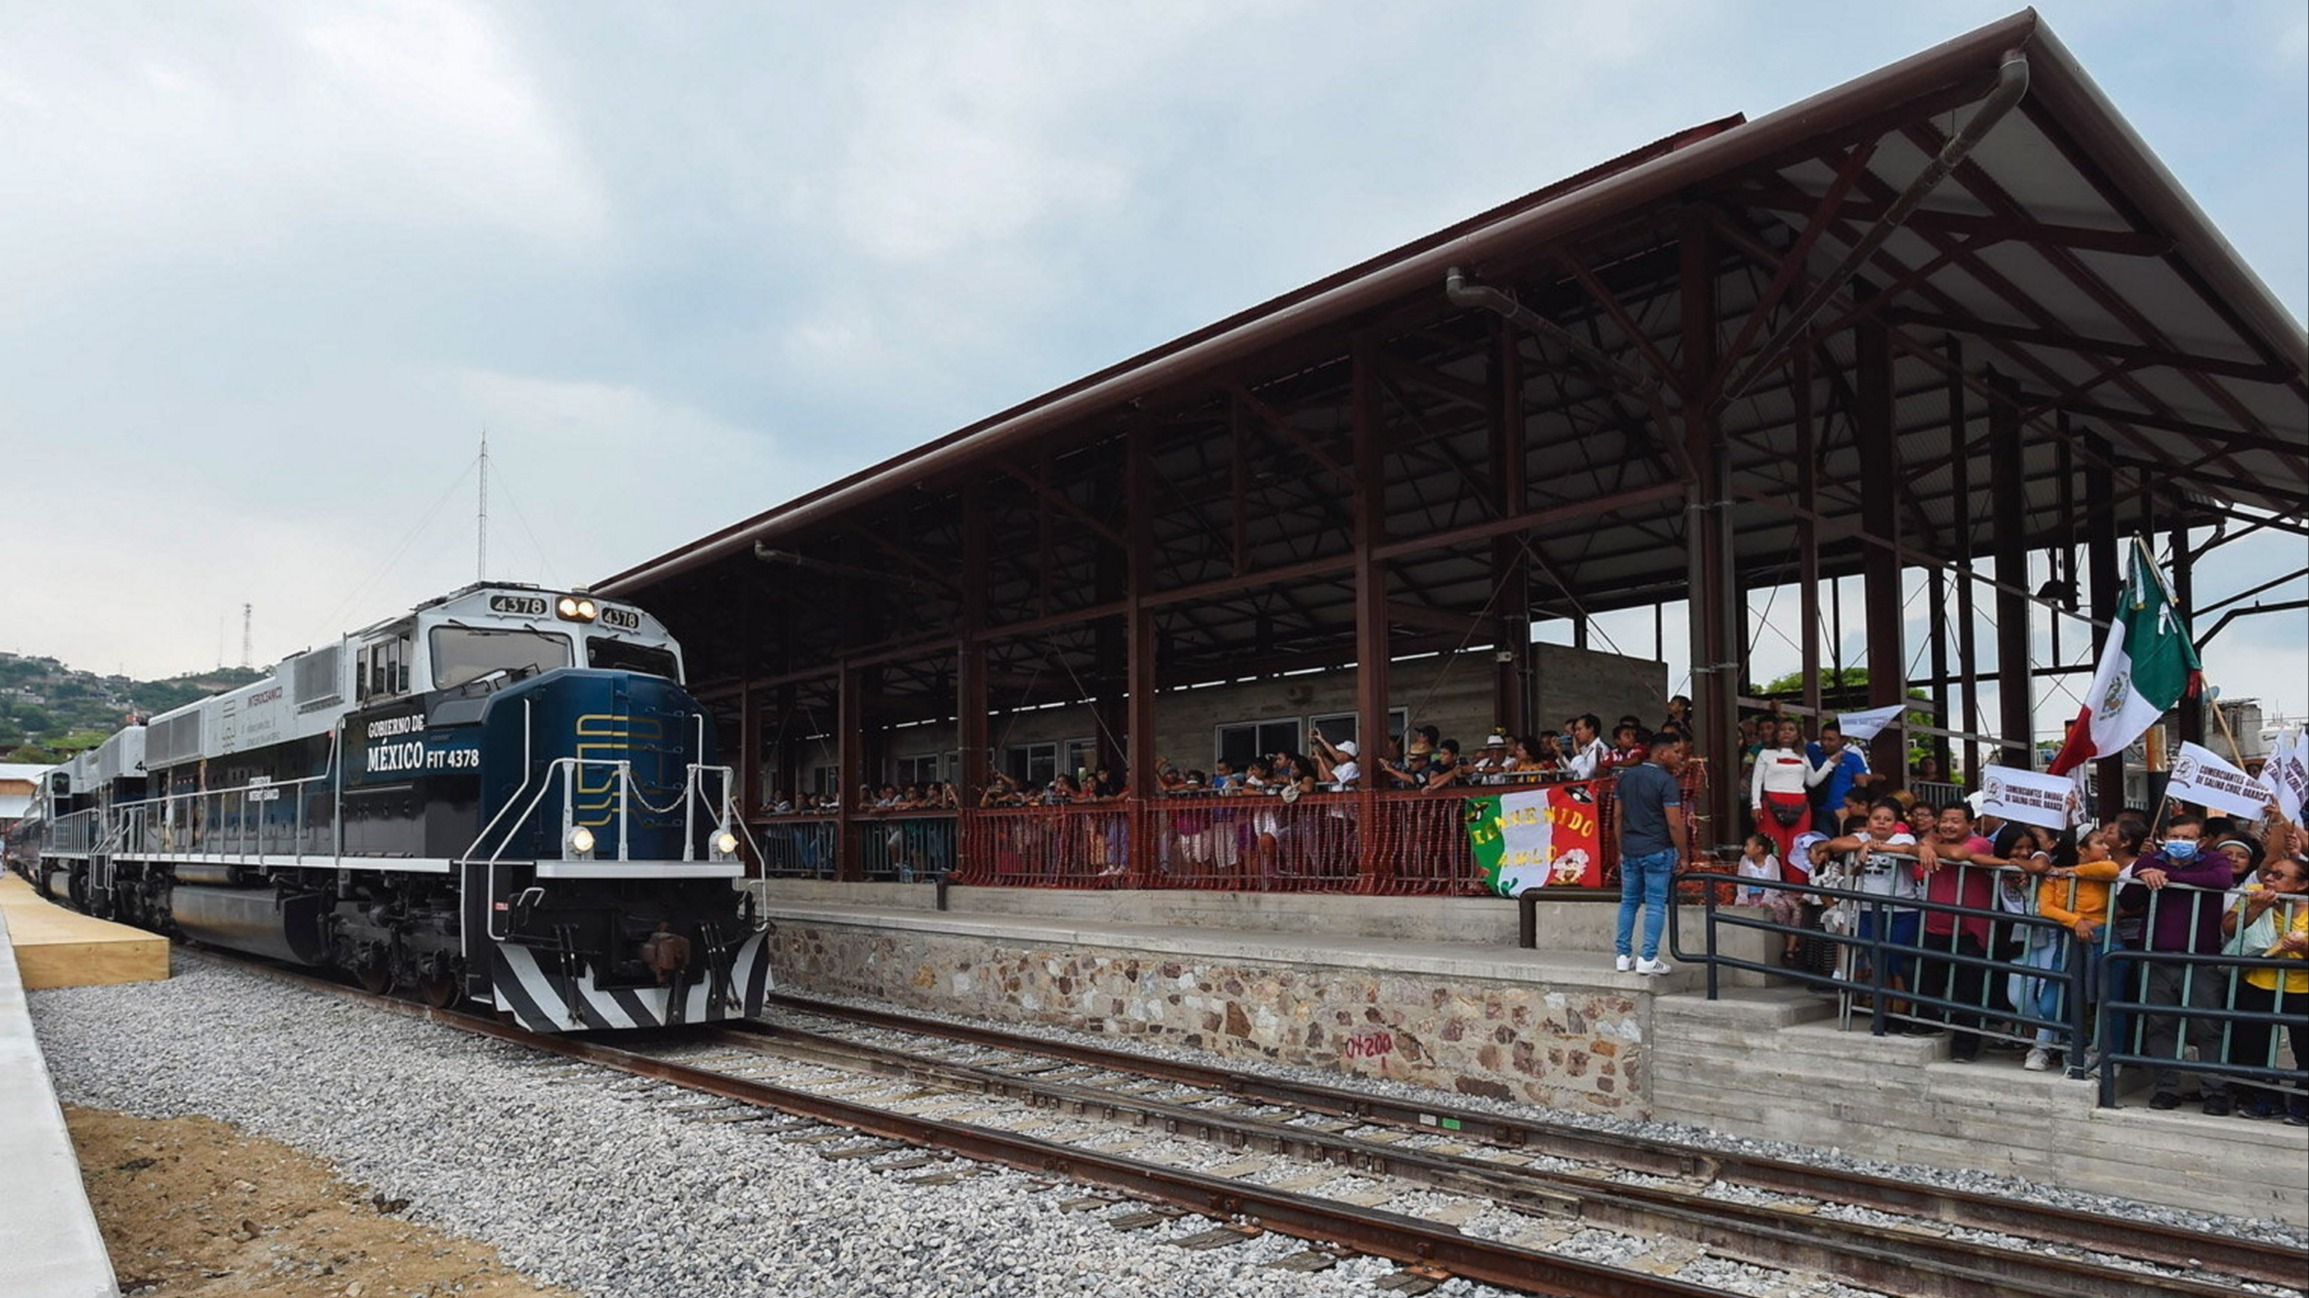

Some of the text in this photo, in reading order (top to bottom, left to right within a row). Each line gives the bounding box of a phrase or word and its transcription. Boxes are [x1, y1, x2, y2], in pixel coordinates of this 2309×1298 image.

[494, 598, 543, 614] 4378
[604, 611, 636, 628] 4378
[368, 714, 425, 738] GOBIERNO DE
[367, 737, 480, 771] MÉXICO FIT 4378
